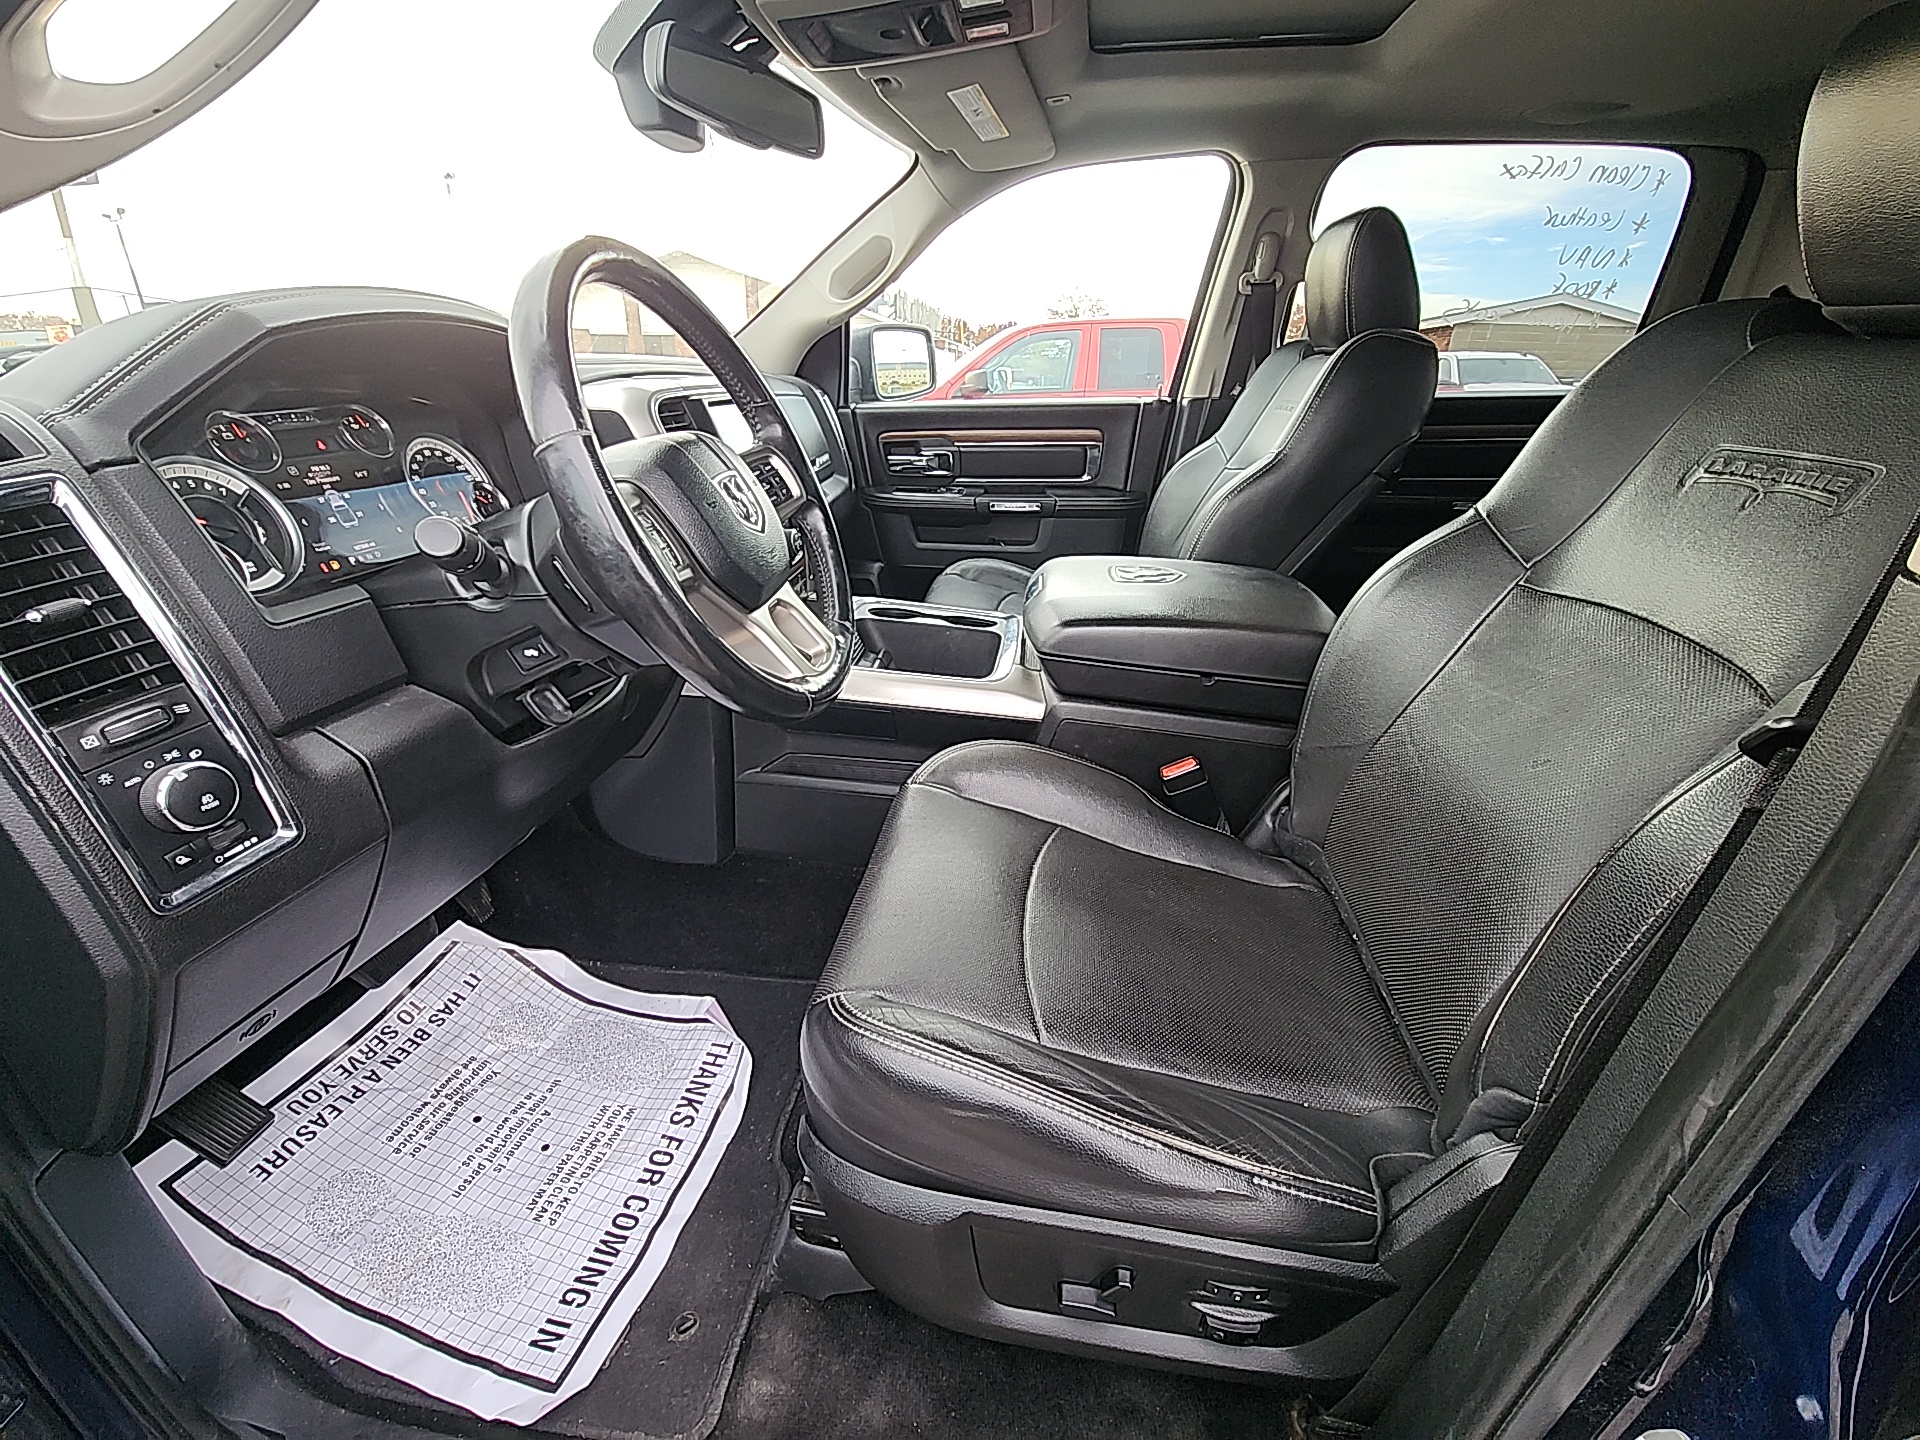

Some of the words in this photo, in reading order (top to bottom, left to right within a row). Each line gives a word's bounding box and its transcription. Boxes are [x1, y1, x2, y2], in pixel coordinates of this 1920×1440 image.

[1704, 456, 1854, 494] LARAMIE
[463, 972, 482, 992] IT
[396, 1000, 427, 1025] TO
[428, 991, 467, 1027] HAS
[332, 1025, 400, 1081] SERVE
[380, 1027, 433, 1071] BEEN
[461, 1055, 477, 1070] are
[361, 1068, 383, 1084] A
[430, 1069, 462, 1100] always
[445, 1059, 492, 1101] improving
[478, 1070, 501, 1088] Your
[546, 1079, 562, 1093] the
[669, 1041, 733, 1128] THANKS
[286, 1080, 338, 1116] YOU
[430, 1101, 447, 1118] our
[510, 1101, 527, 1115] the
[524, 1092, 537, 1101] in
[525, 1095, 547, 1116] most
[424, 1088, 479, 1141] suggestions
[540, 1109, 552, 1117] A
[588, 1104, 611, 1129] WITH
[602, 1104, 627, 1130] YOUR
[621, 1107, 637, 1123] WE
[248, 1084, 368, 1183] PLEASURE
[392, 1117, 430, 1155] service
[484, 1117, 530, 1163] important
[485, 1117, 512, 1144] world
[504, 1118, 543, 1162] customer
[570, 1131, 592, 1152] THIS
[602, 1124, 626, 1150] HAVE
[408, 1143, 427, 1158] for
[475, 1144, 488, 1154] to
[560, 1131, 606, 1184] CARPETING
[636, 1134, 683, 1187] FOR
[493, 1163, 506, 1174] is
[543, 1153, 573, 1186] PAPER
[581, 1151, 607, 1178] TRIED
[452, 1162, 487, 1198] person
[568, 1181, 584, 1194] TO
[525, 1188, 547, 1213] MAT
[532, 1186, 563, 1222] CLEAN
[550, 1196, 571, 1226] KEEP
[558, 1193, 649, 1309] COMING
[528, 1318, 573, 1353] IN
